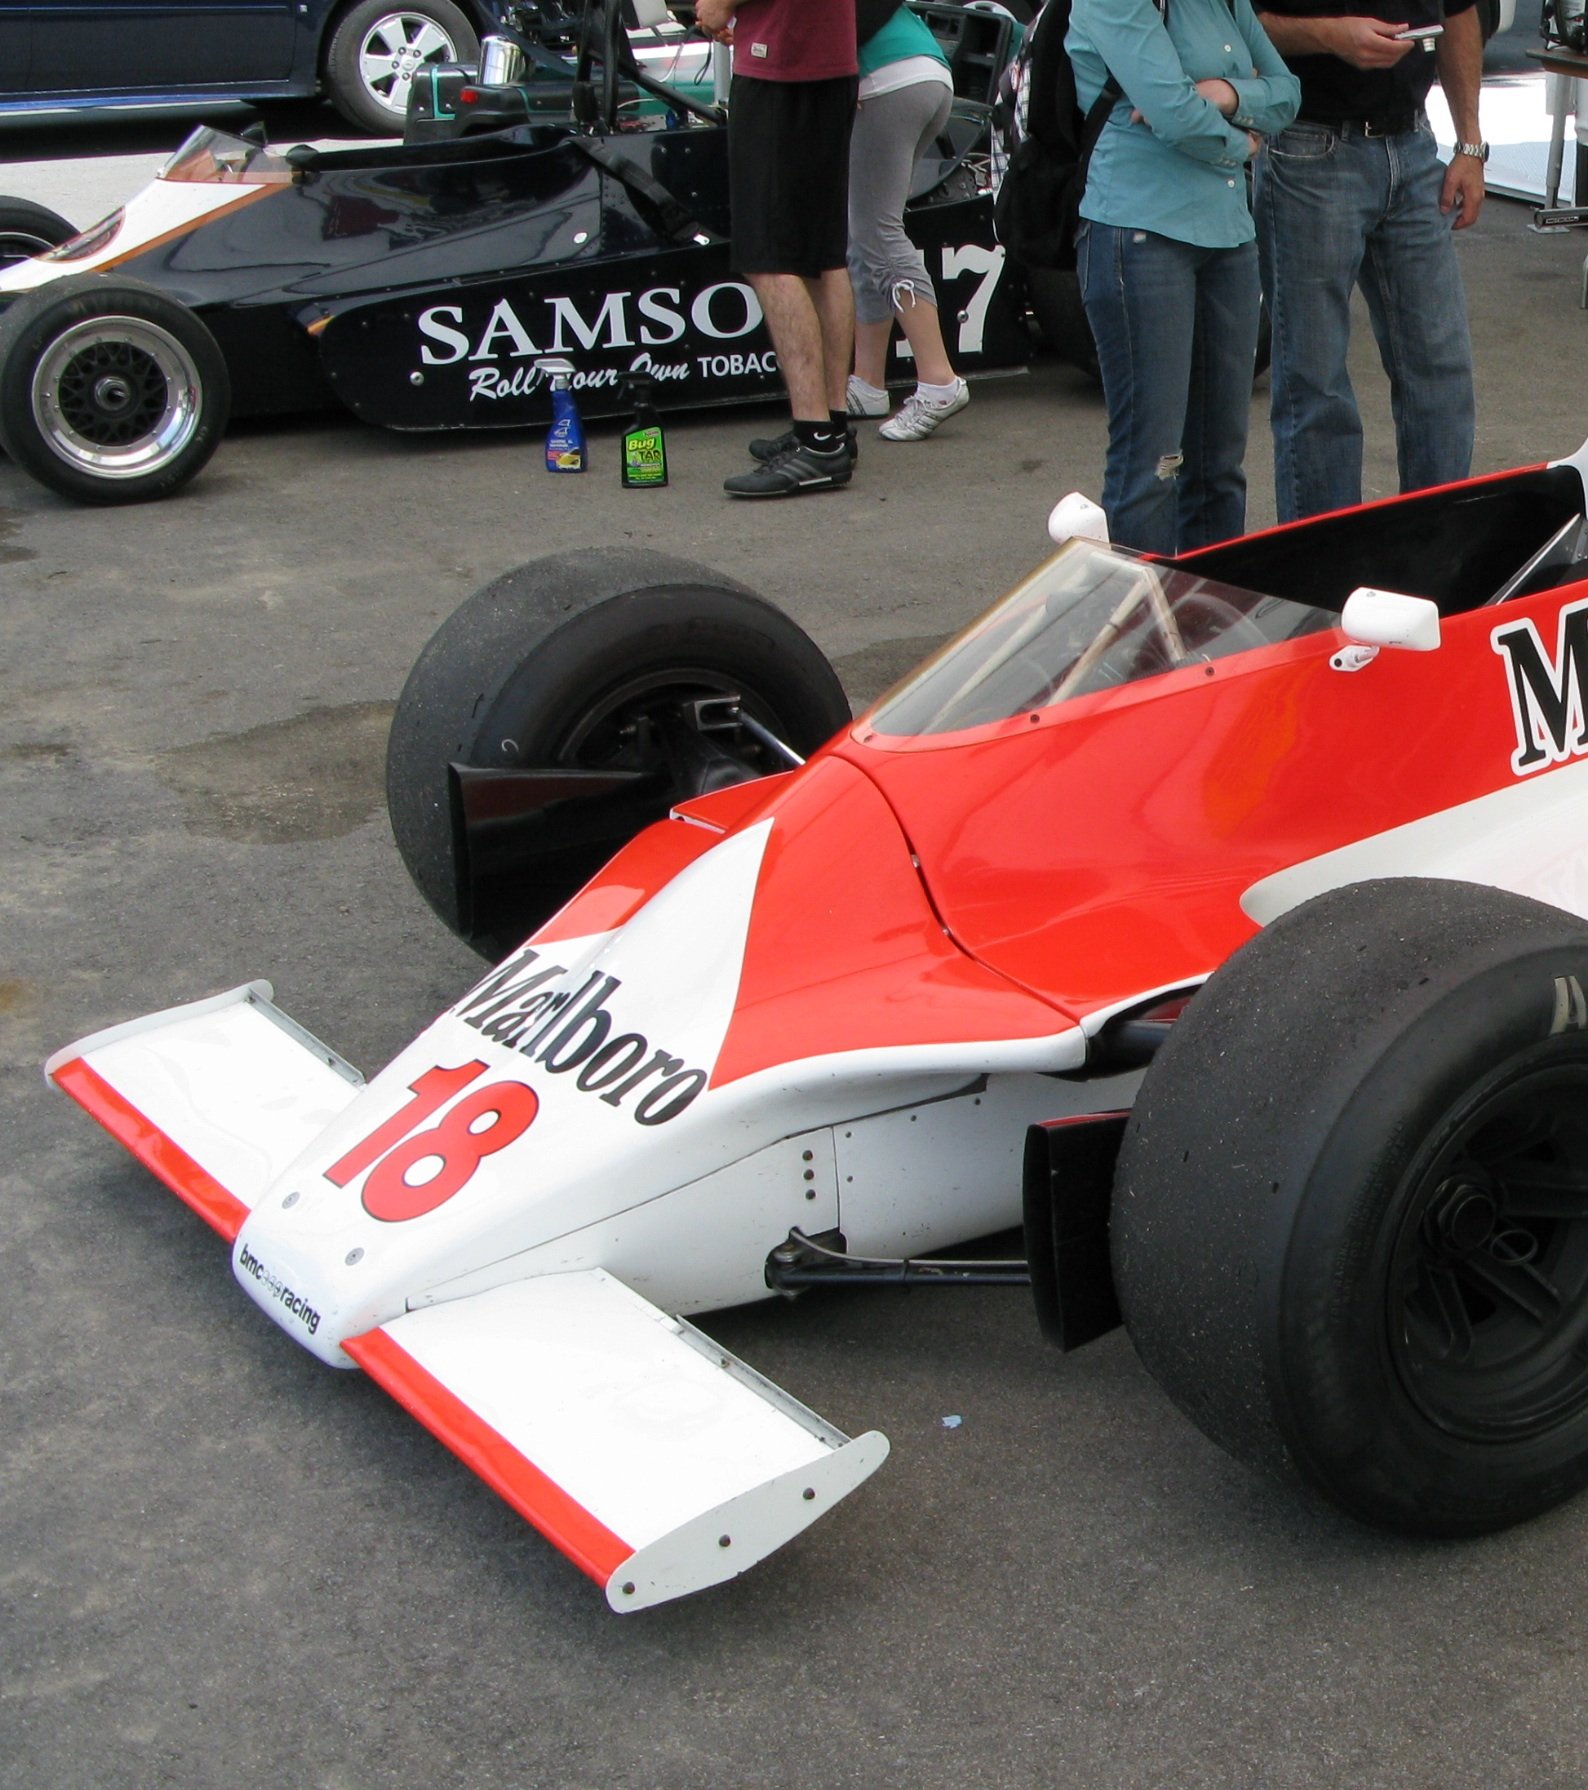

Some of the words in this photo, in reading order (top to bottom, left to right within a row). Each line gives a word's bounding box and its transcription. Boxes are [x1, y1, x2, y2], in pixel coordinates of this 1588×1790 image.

[468, 366, 539, 402] Roll
[628, 438, 655, 451] Bug
[448, 947, 709, 1127] Marlboro
[322, 1058, 540, 1224] 18
[240, 1243, 265, 1281] bmc
[280, 1286, 322, 1335] racing
